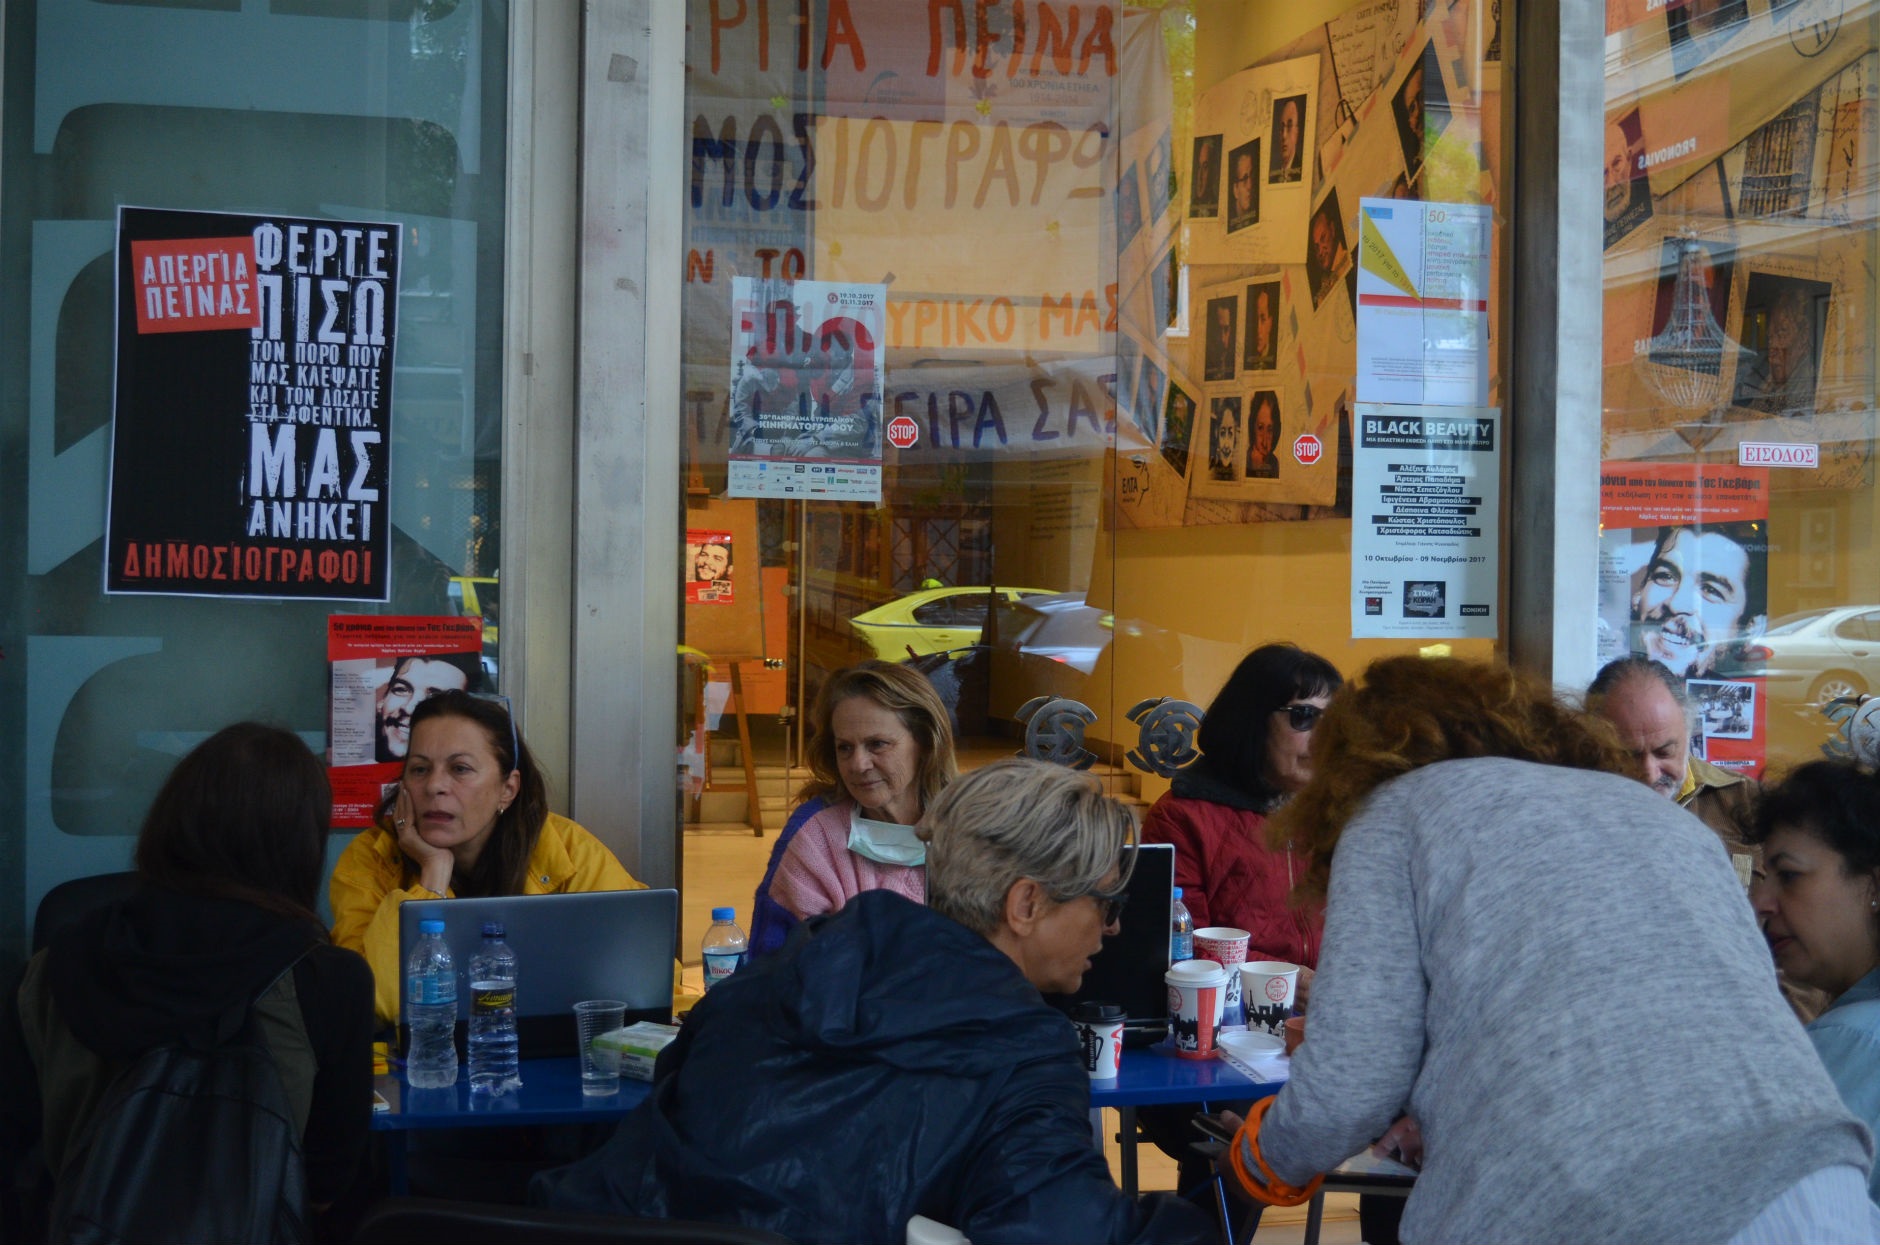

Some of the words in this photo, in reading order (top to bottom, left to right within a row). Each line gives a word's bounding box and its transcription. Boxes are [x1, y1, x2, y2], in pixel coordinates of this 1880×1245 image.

[926, 0, 1118, 78] ΠΕΙΝΑ
[1009, 79, 1025, 89] 100
[1027, 80, 1065, 90] ΧΡΟΝΙΑ
[1428, 209, 1446, 223] 50
[251, 223, 389, 279] ΦΕΡΤΕ
[143, 250, 249, 285] ΑΠΕΡΓΙΑ
[754, 248, 807, 284] ΤΟ
[145, 283, 251, 320] ΠΕΙΝΑΣ
[251, 274, 386, 346] ΠΙΣΩ
[1038, 282, 1118, 341] ΜΑΣ
[251, 340, 286, 362] ΤΟΝ
[295, 342, 340, 365] ΠΟΡΟ
[348, 345, 382, 367] ΠΟΥ
[251, 362, 290, 385] ΜΑΣ
[297, 365, 381, 390] ΚΛΕΨΑΤΕ
[251, 385, 277, 404] ΚΑΙ
[285, 386, 315, 406] ΤΟΝ
[322, 388, 379, 409] ΔΩΣΑΤΕ
[250, 403, 279, 423] ΣΤΑ
[287, 405, 378, 427] ΑΦΕΝΤΙΚΑ.
[772, 414, 810, 422] ΠΑΝΟΡΑΜΑ
[759, 420, 854, 432] ΚΙΝΗΜΑΤΟΓΡΑΦΟΥ
[890, 425, 915, 440] STOP
[1366, 420, 1420, 435] BLACK
[1425, 422, 1490, 437] BEAUTY
[1295, 443, 1318, 457] STOP
[1745, 446, 1815, 463] ΕΙΣΟΔΟΣ
[251, 423, 381, 502] ΜΑΣ
[1718, 476, 1760, 490] Γκεβάρα
[1383, 495, 1417, 504] Ιφιγένεια
[1396, 506, 1429, 514] Δέσποινα
[248, 500, 372, 543] ΑΝΗΚΕΙ
[1388, 516, 1415, 524] Κώστας
[1416, 517, 1465, 526] Χριστόπουλος
[1380, 527, 1427, 536] Χριστόφορος
[124, 542, 373, 586] ΔΗΜΟΣΙΟΓΡΑΦΟΙ
[1375, 555, 1414, 563] Οκτωβρίου
[1431, 556, 1467, 564] Νοεμβρίου
